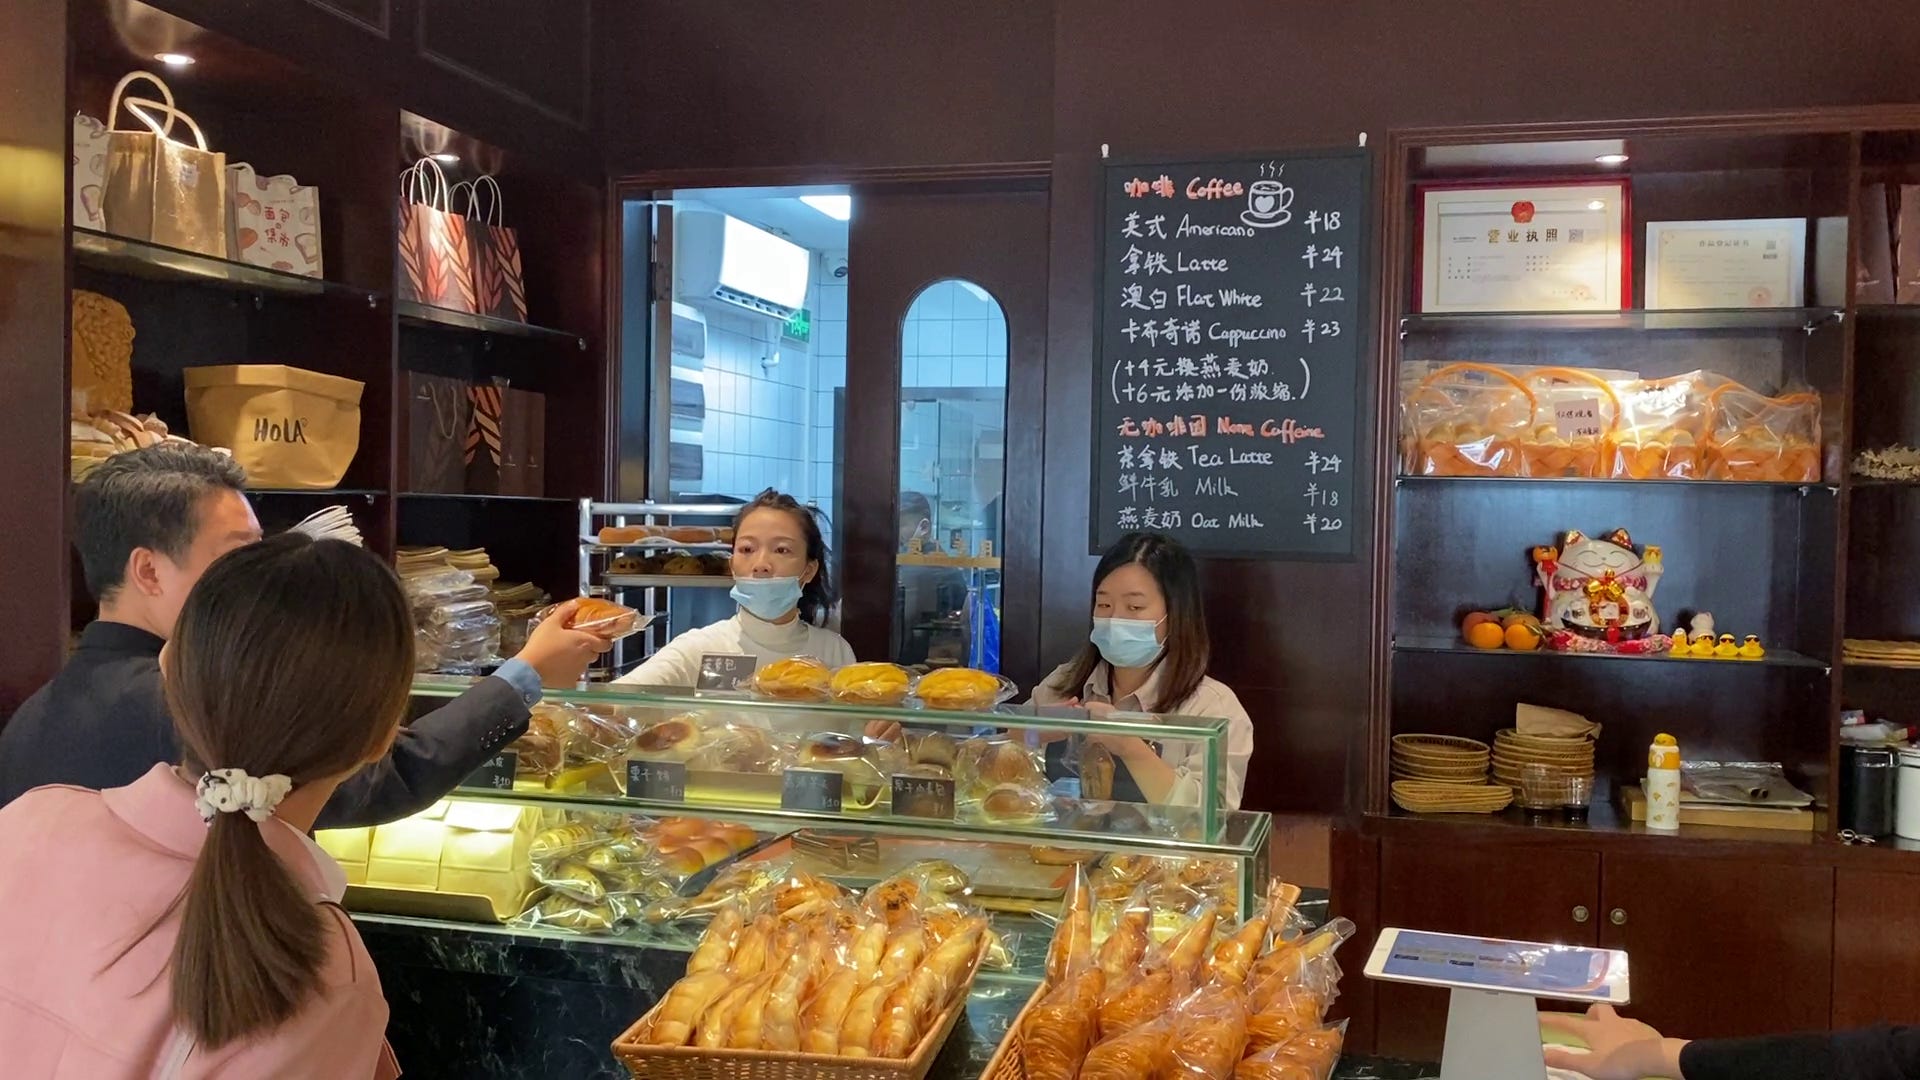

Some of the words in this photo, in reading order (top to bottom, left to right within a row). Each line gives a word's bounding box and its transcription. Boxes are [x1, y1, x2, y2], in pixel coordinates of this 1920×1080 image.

[1187, 177, 1244, 200] Coffee
[1121, 211, 1167, 239] 美式
[1176, 214, 1255, 239] Americano
[1304, 211, 1341, 234] ¥18
[1488, 228, 1558, 244] 营业执照
[1121, 244, 1173, 275] 拿铁
[1178, 252, 1229, 273] Latte
[1302, 245, 1343, 269] ¥24
[1121, 283, 1167, 311] 澳白
[1177, 285, 1215, 308] Flat
[1219, 289, 1263, 308] White
[1301, 283, 1345, 307] ¥22
[1121, 318, 1201, 347] 卡布奇诺
[1208, 322, 1287, 348] Cappuccino
[1301, 319, 1341, 344] ¥23
[1117, 415, 1207, 438] 无咖啡因
[1117, 444, 1183, 471] 茶拿铁
[1187, 445, 1223, 467] Tea
[1230, 448, 1273, 466] Latte
[1304, 451, 1341, 475] ¥24
[1117, 473, 1179, 502] 鲜牛乳
[1195, 477, 1239, 497] Milk
[1303, 483, 1339, 507] ¥18
[1117, 506, 1181, 530] 燕麦奶
[1192, 512, 1219, 529] Oat
[1228, 513, 1264, 529] Milk
[1303, 512, 1342, 534] ¥20
